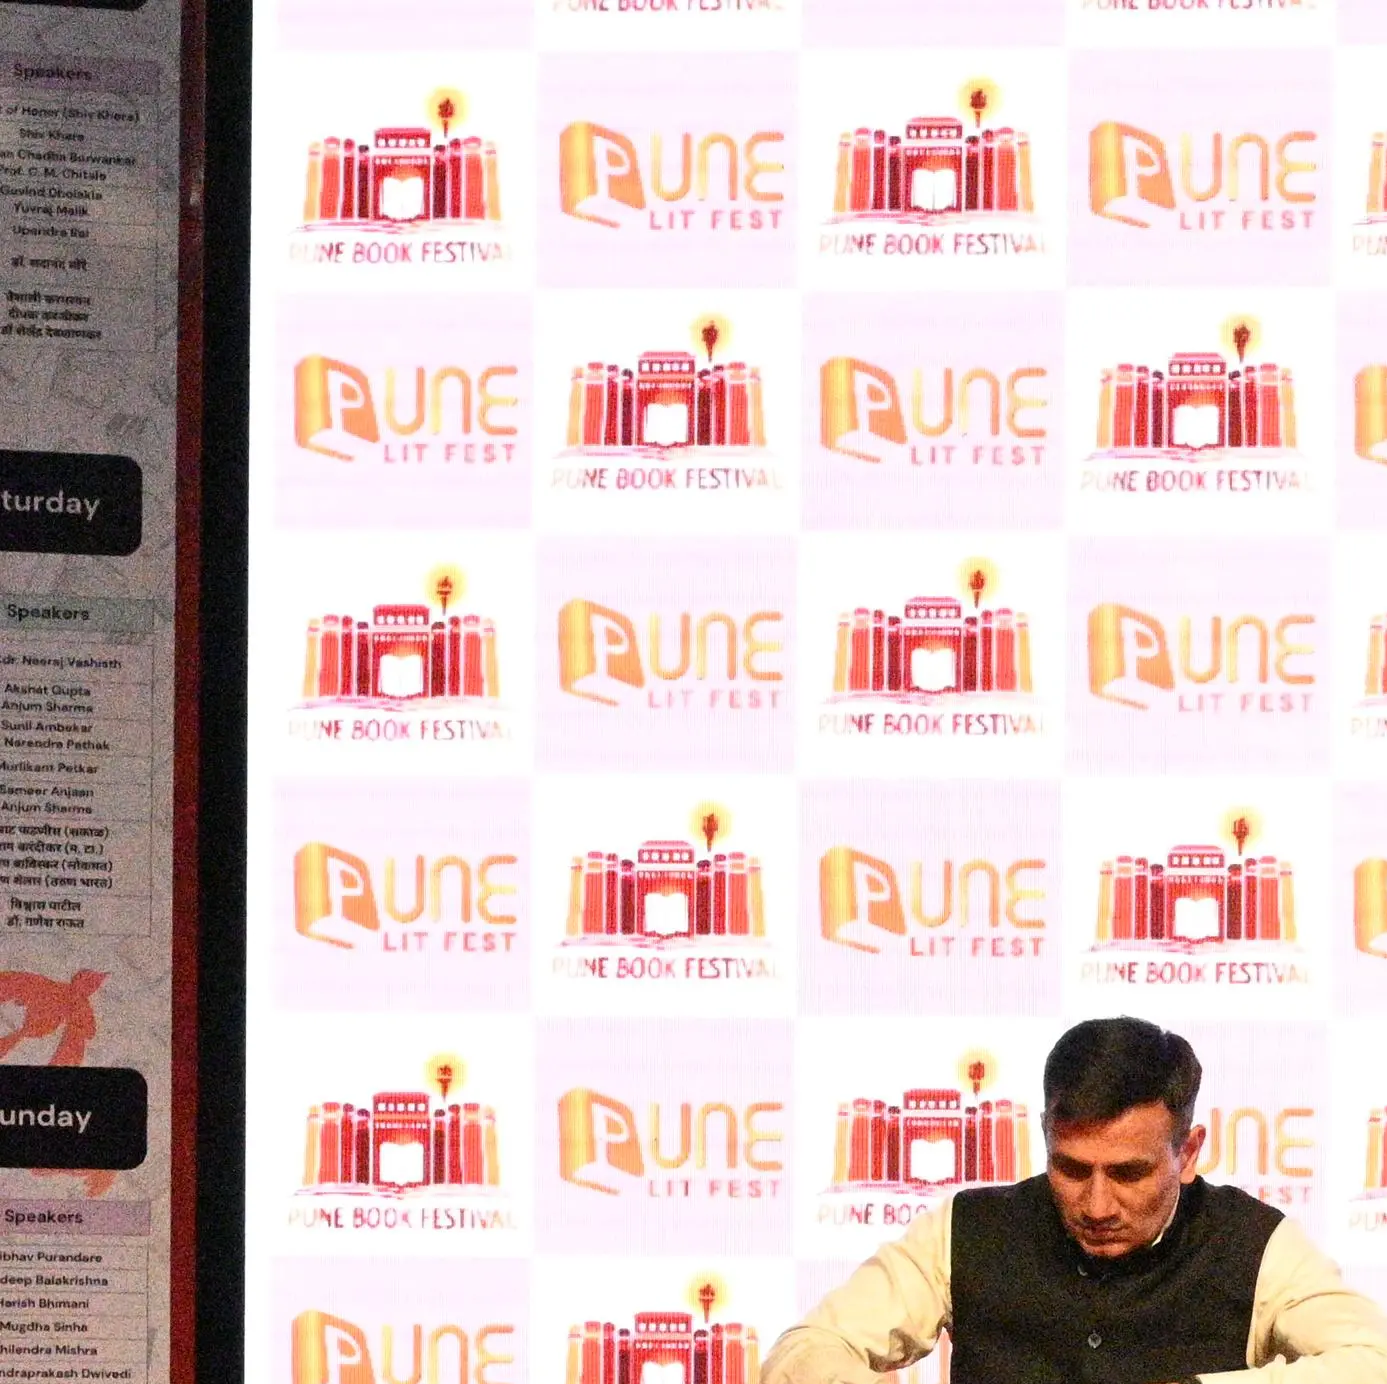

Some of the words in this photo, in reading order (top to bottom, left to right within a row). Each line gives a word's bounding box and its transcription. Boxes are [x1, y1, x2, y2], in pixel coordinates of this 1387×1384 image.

[559, 121, 785, 215] PUNE
[649, 209, 694, 231] LIT
[710, 209, 782, 231] FEST
[294, 355, 519, 449] PUNE
[384, 443, 428, 464] LIT
[444, 443, 515, 464] FEST
[615, 468, 677, 490] BOOK
[7, 604, 91, 622] Speakers
[558, 599, 784, 694] PUNE
[648, 690, 694, 709] LIT
[710, 690, 778, 709] FEST
[294, 842, 517, 936] PUNE
[383, 931, 427, 953] LIT
[443, 931, 516, 953] FEST
[614, 956, 677, 980] BOOK
[5, 1208, 84, 1226] Speakers
